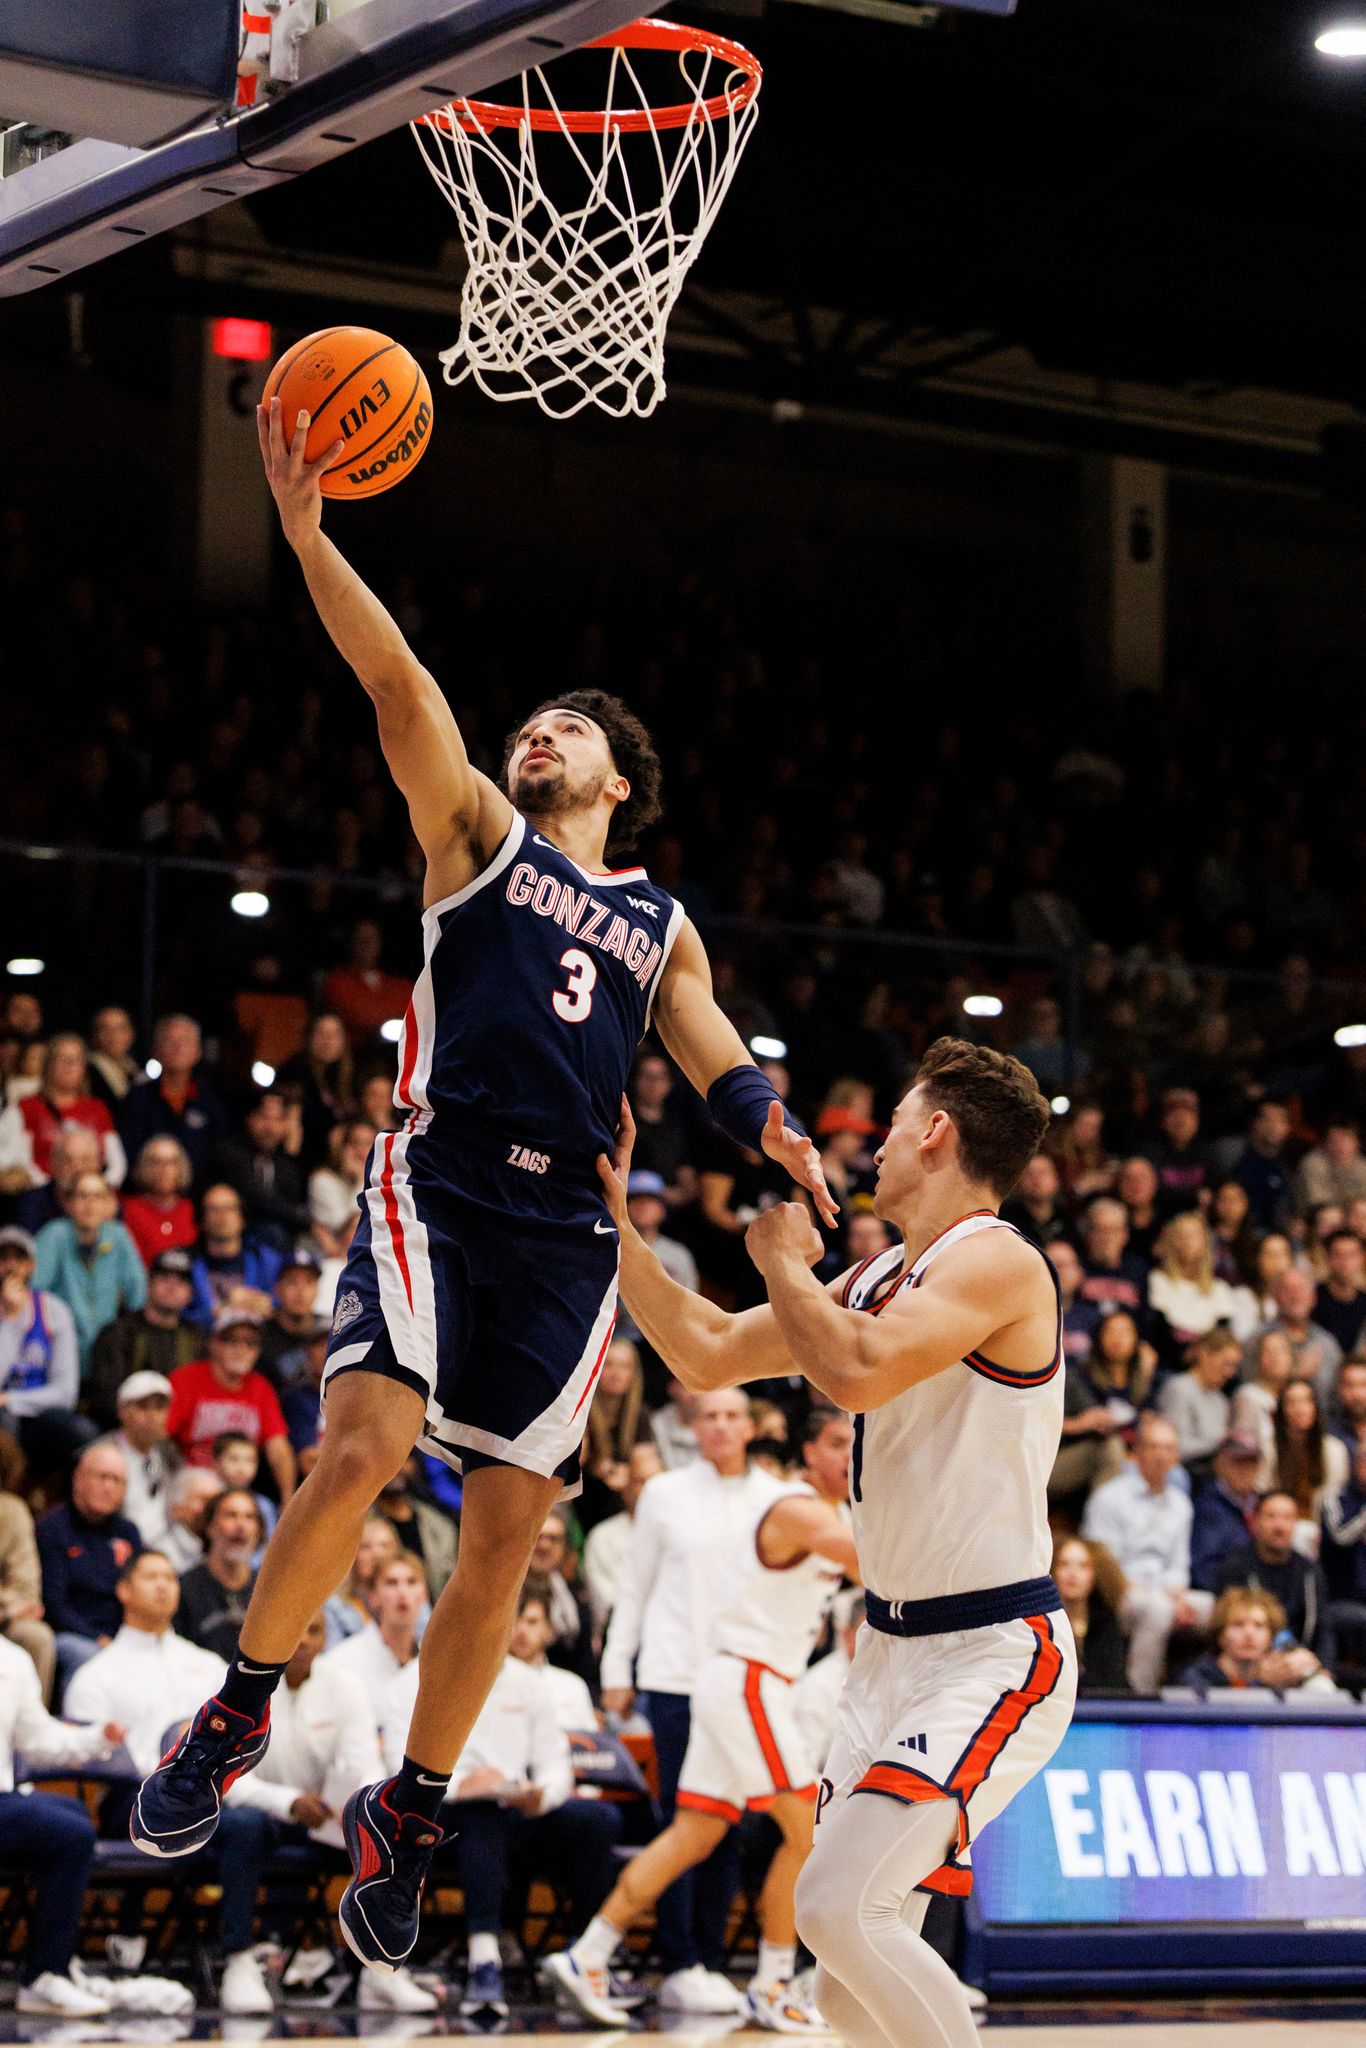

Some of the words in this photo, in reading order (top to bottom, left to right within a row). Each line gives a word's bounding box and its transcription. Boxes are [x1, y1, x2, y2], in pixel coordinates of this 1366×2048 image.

[346, 401, 432, 485] Wilson
[505, 862, 663, 991] GONZAGA
[552, 947, 598, 1024] 3
[506, 1144, 551, 1175] ZAGS
[1043, 1769, 1268, 1878] EARN
